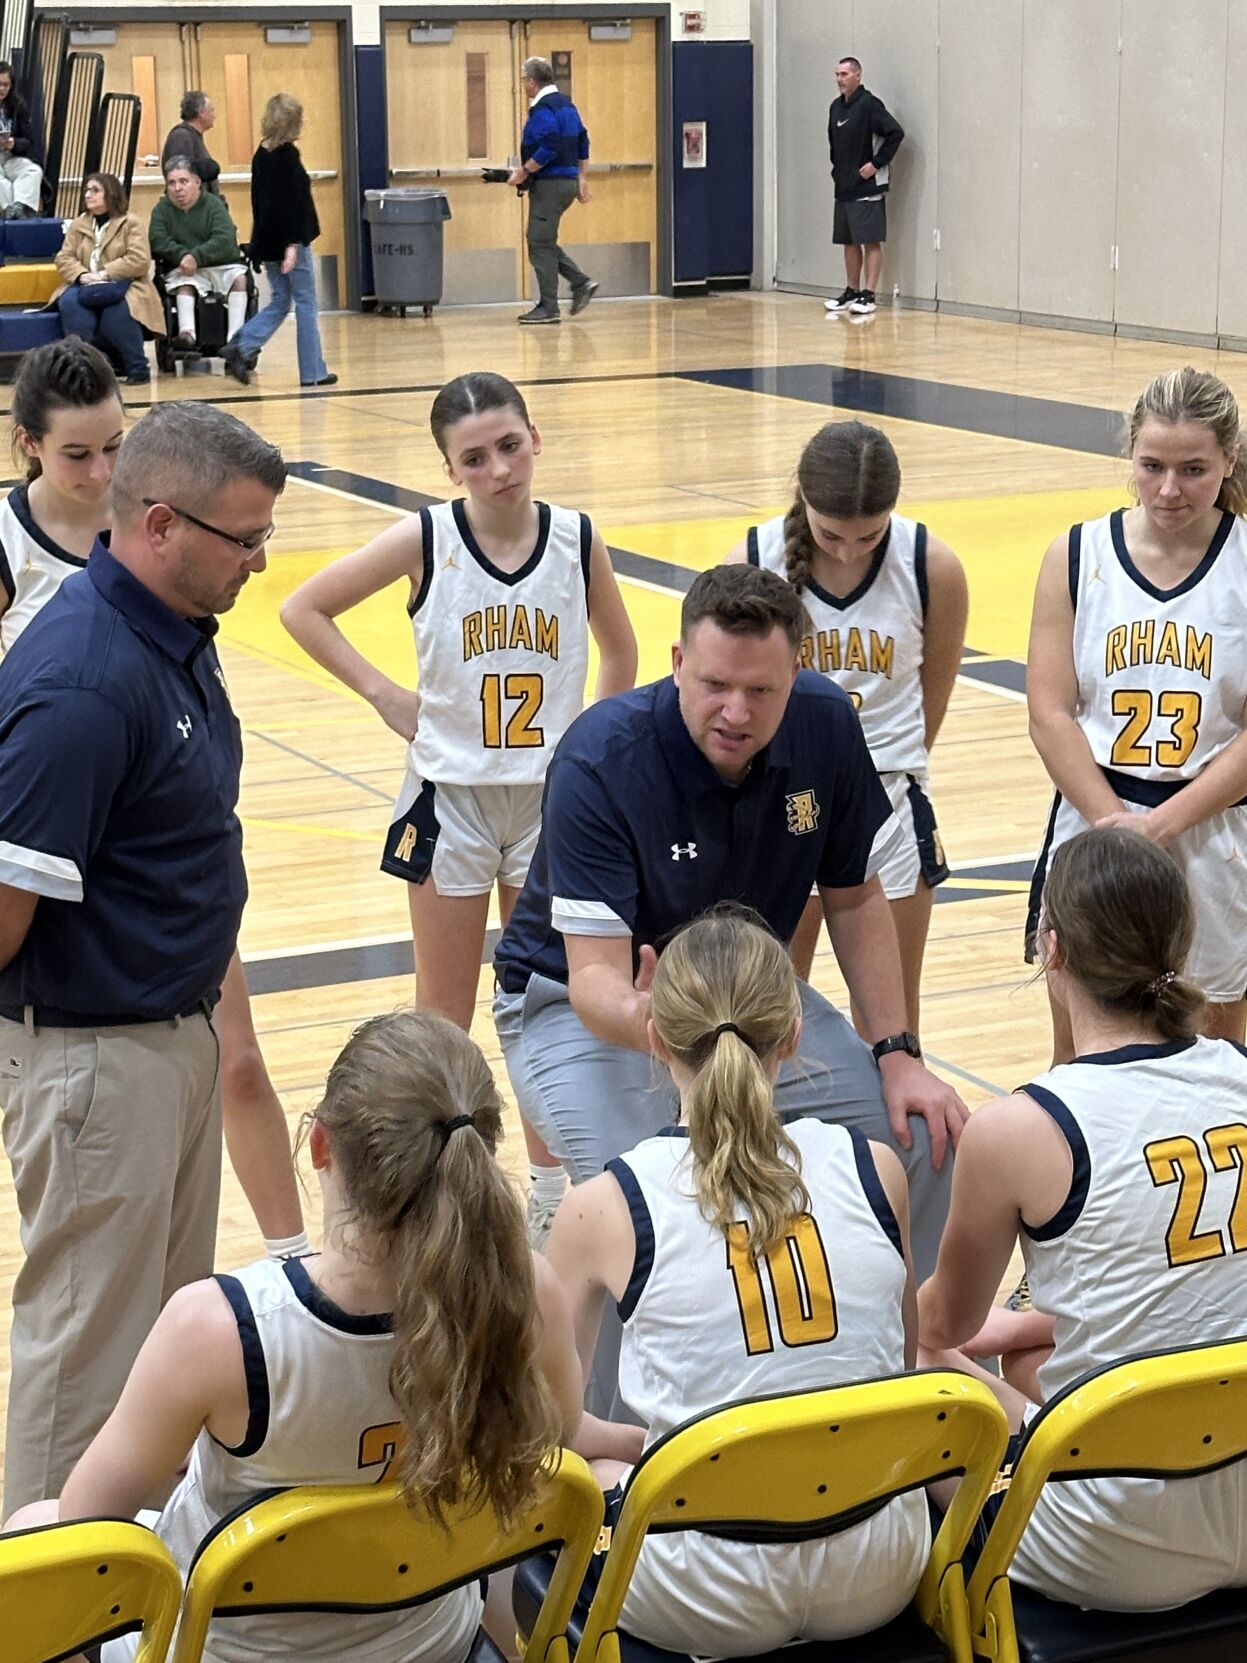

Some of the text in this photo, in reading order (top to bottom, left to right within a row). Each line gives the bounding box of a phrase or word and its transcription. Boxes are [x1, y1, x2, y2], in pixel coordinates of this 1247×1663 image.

[462, 604, 559, 662] RHAM
[797, 626, 895, 680] RHAM
[1105, 619, 1213, 681] RHAM
[480, 673, 545, 748] 12
[1110, 689, 1202, 768] 23
[394, 822, 417, 862] R
[725, 1212, 839, 1357] 10
